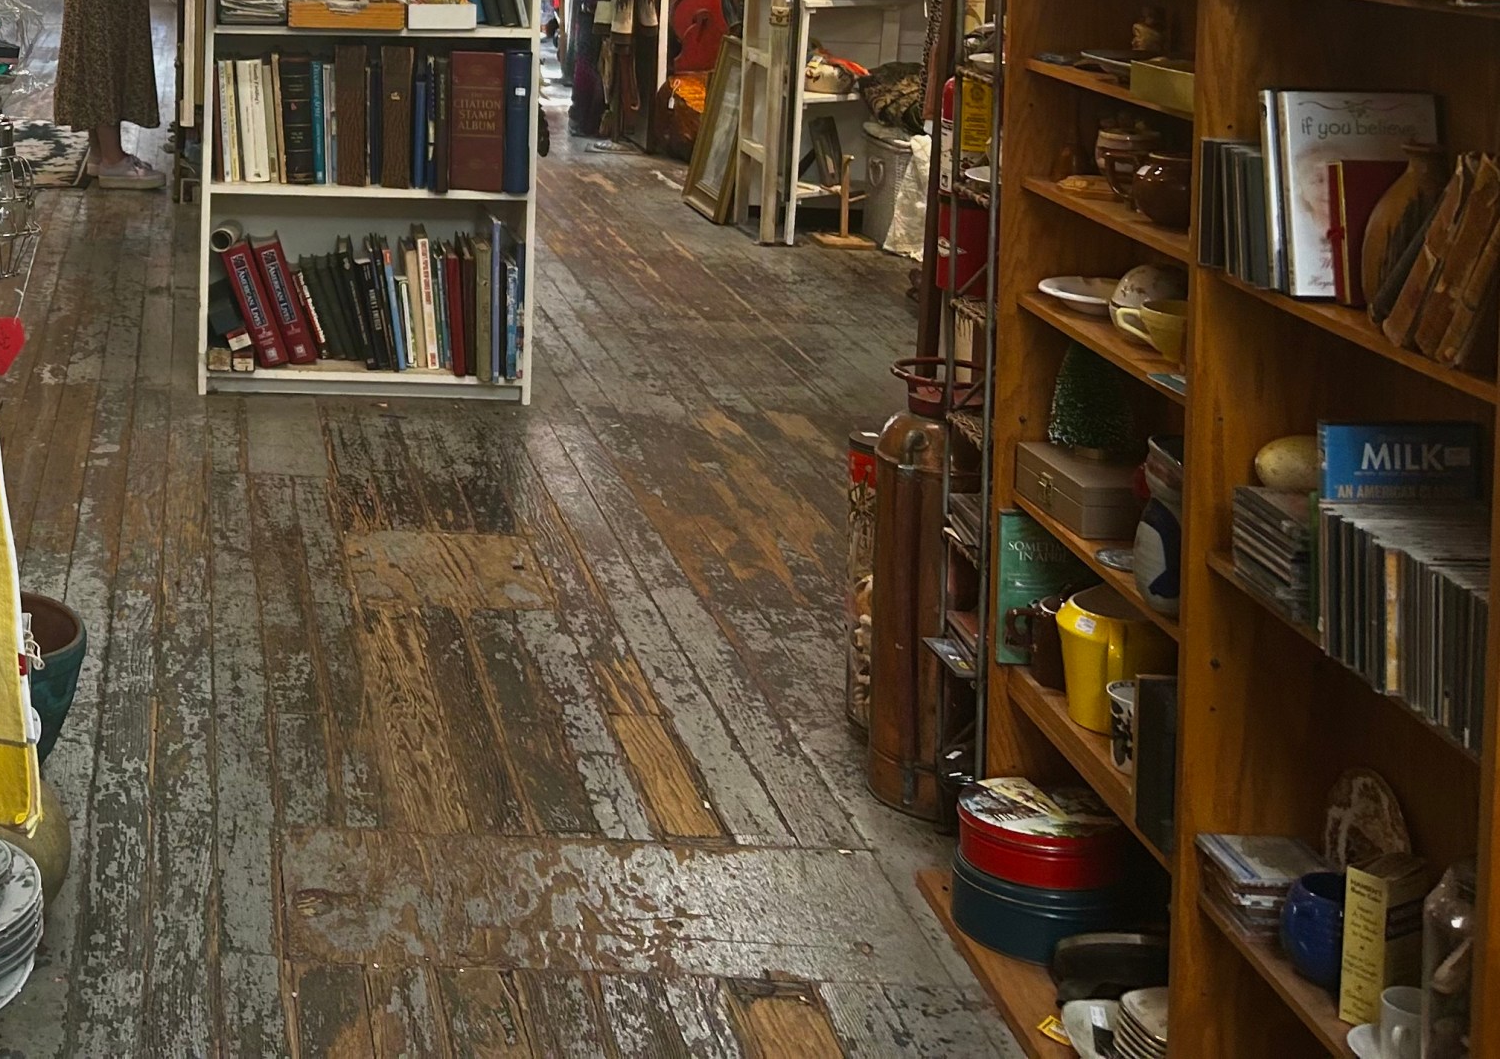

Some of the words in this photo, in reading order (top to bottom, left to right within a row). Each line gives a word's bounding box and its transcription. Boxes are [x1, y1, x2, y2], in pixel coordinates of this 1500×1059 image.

[459, 110, 496, 120] STAMP
[457, 121, 497, 131] ALBUM
[1301, 116, 1313, 135] if
[1318, 122, 1351, 140] you
[1361, 442, 1444, 471] MILK
[1019, 551, 1033, 561] IN
